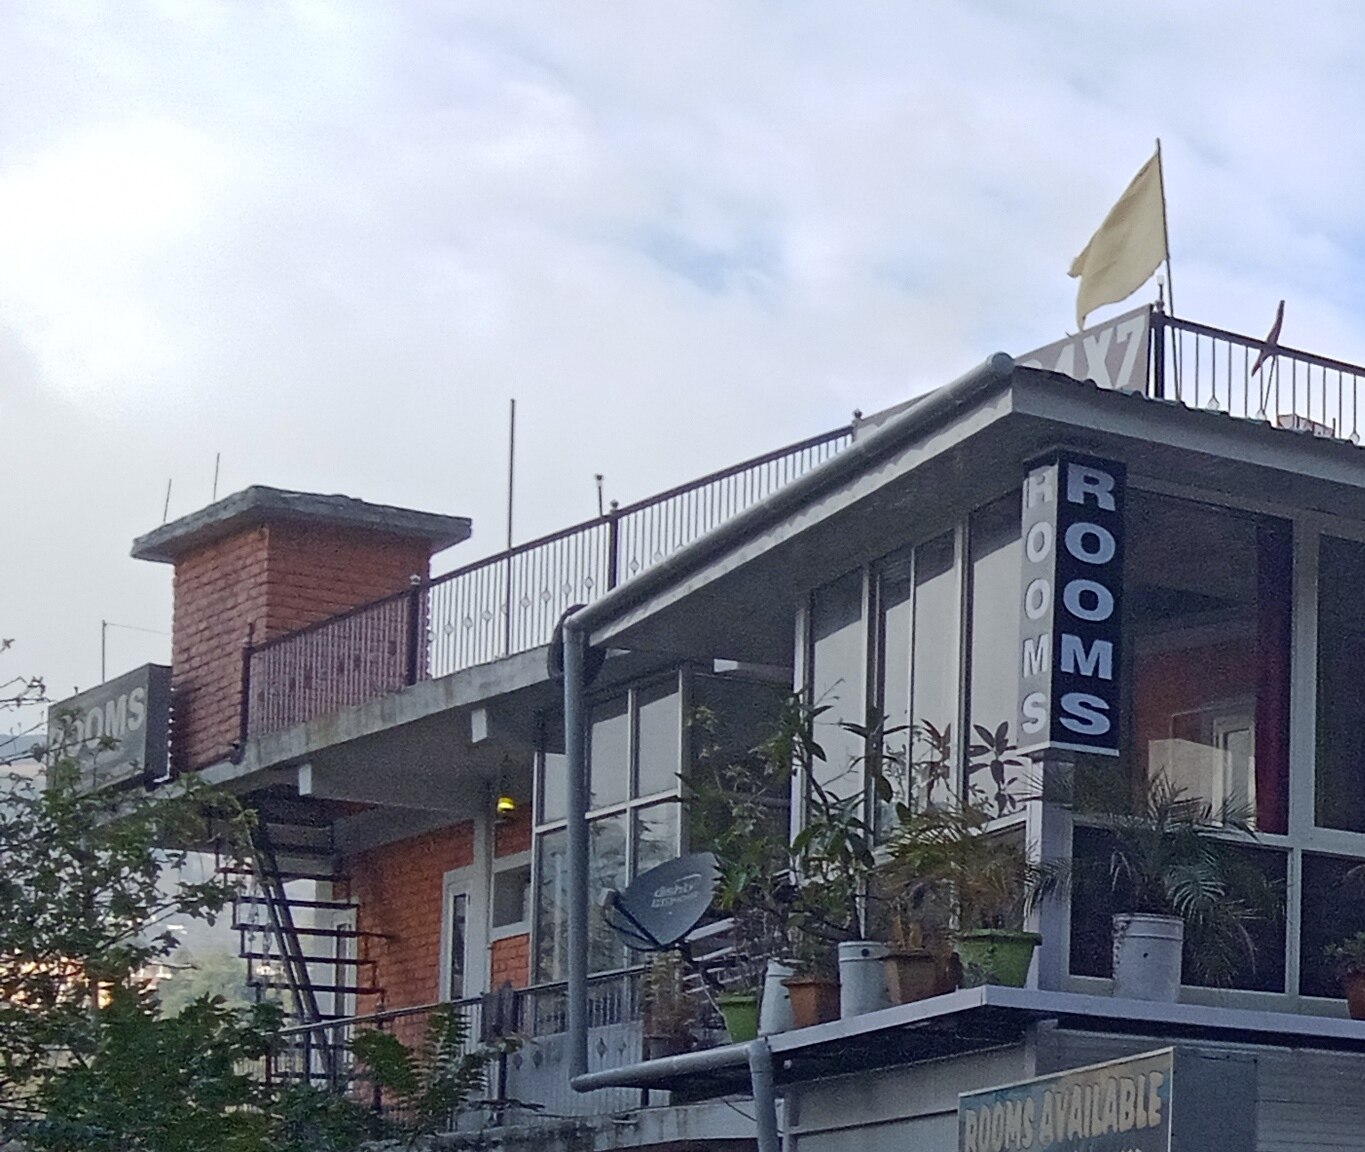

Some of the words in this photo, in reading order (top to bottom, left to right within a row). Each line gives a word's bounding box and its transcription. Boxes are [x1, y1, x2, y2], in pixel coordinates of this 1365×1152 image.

[1022, 466, 1054, 735] ROOMS
[1059, 463, 1117, 736] ROOMS
[1039, 1071, 1164, 1146] AVAILABLE
